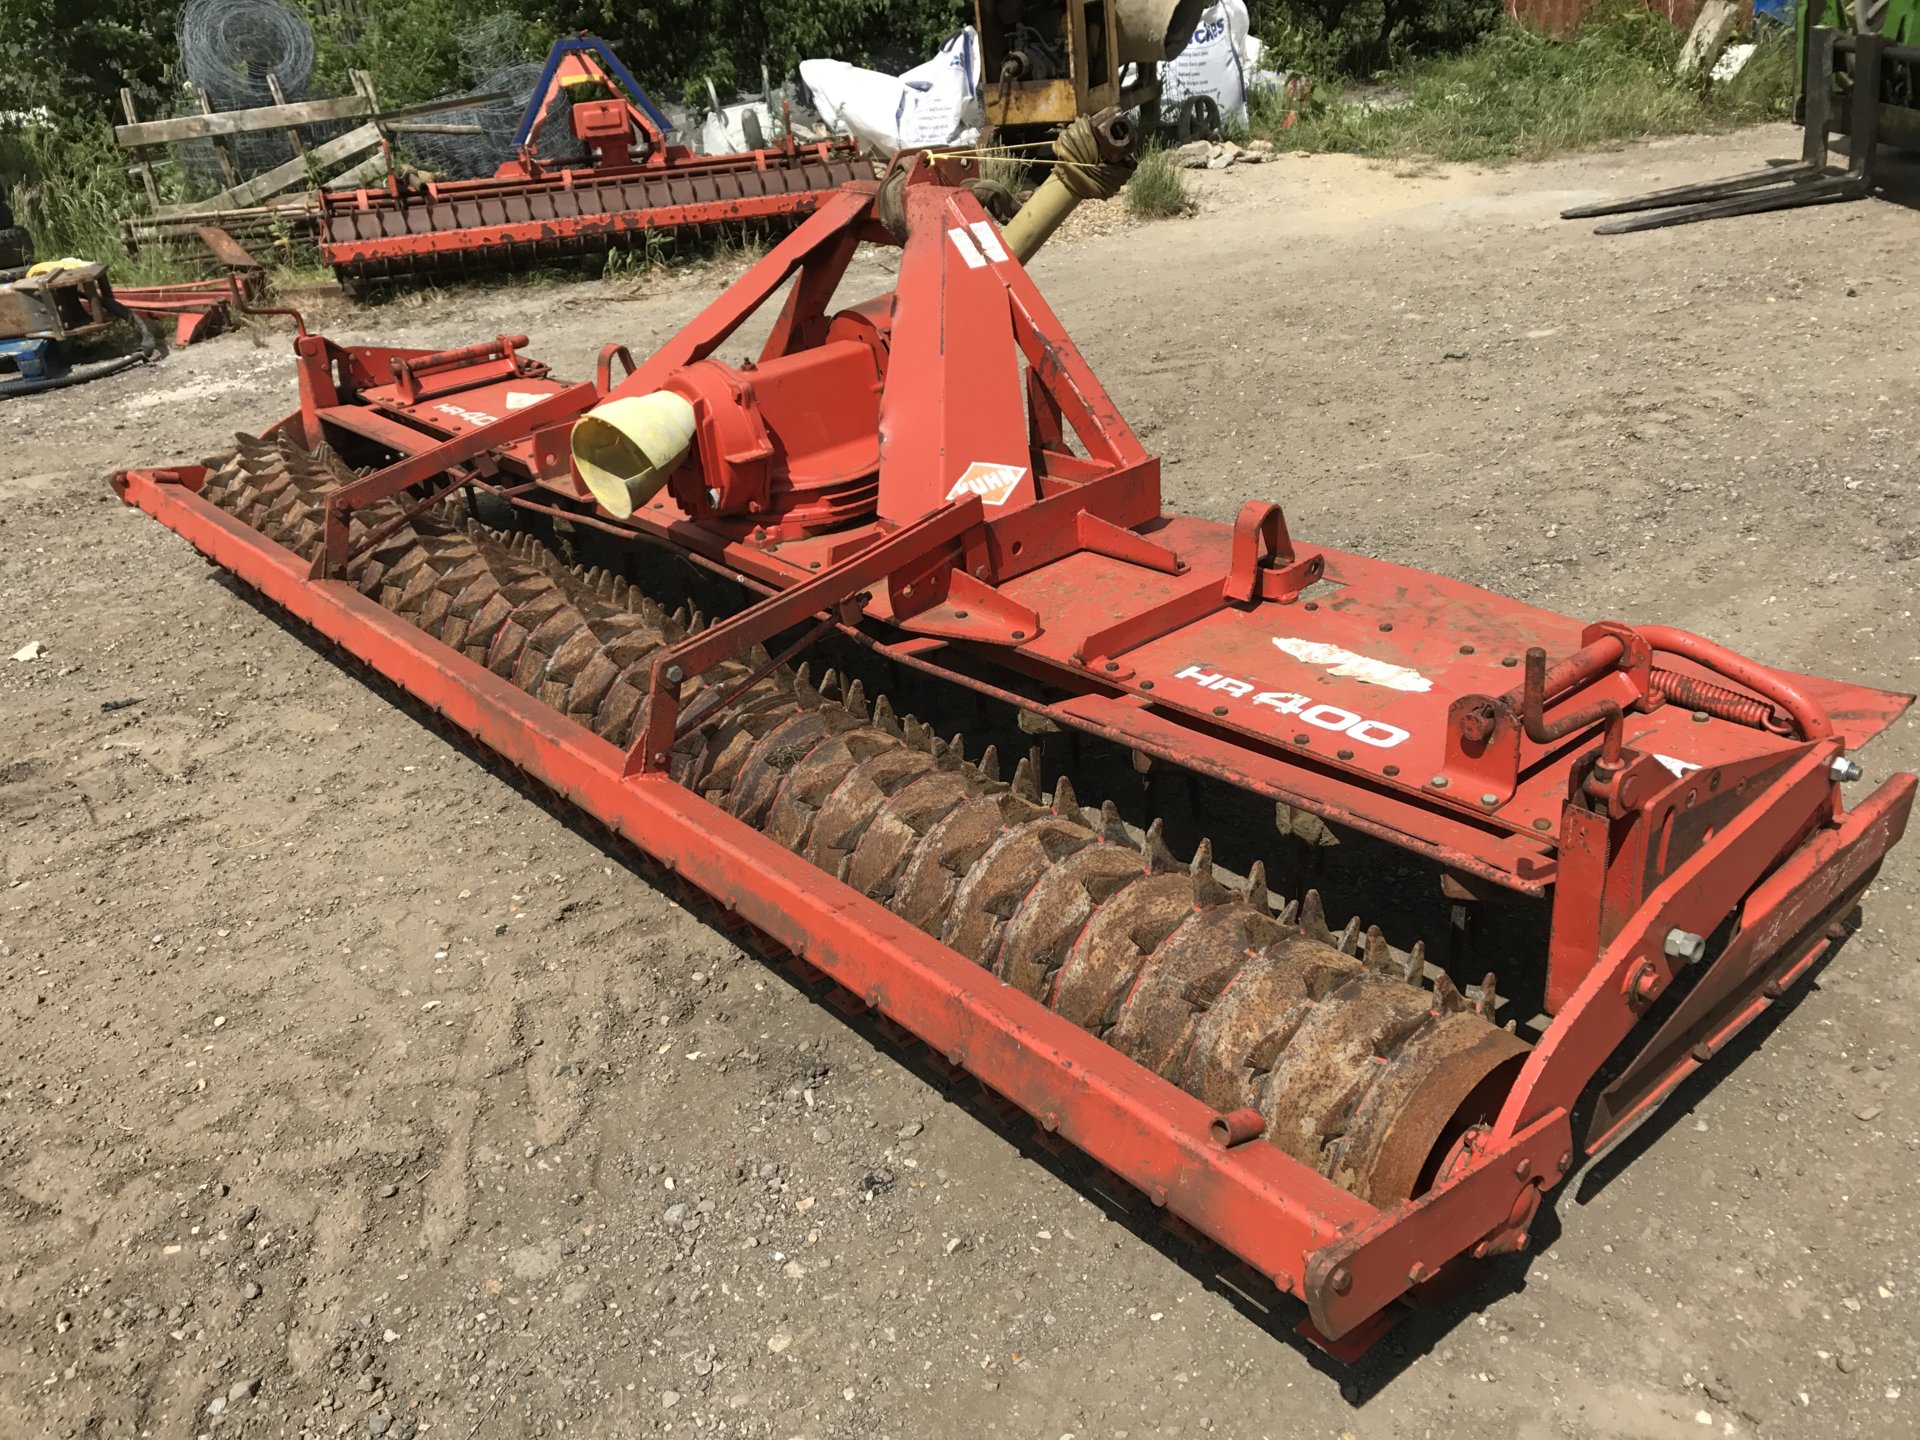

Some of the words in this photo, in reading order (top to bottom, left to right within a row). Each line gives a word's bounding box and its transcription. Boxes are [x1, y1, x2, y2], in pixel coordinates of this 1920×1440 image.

[432, 403, 466, 416] HR
[459, 411, 498, 427] 40
[957, 469, 1018, 495] KUHN
[1174, 665, 1255, 698] HR
[1252, 691, 1411, 748] 400
